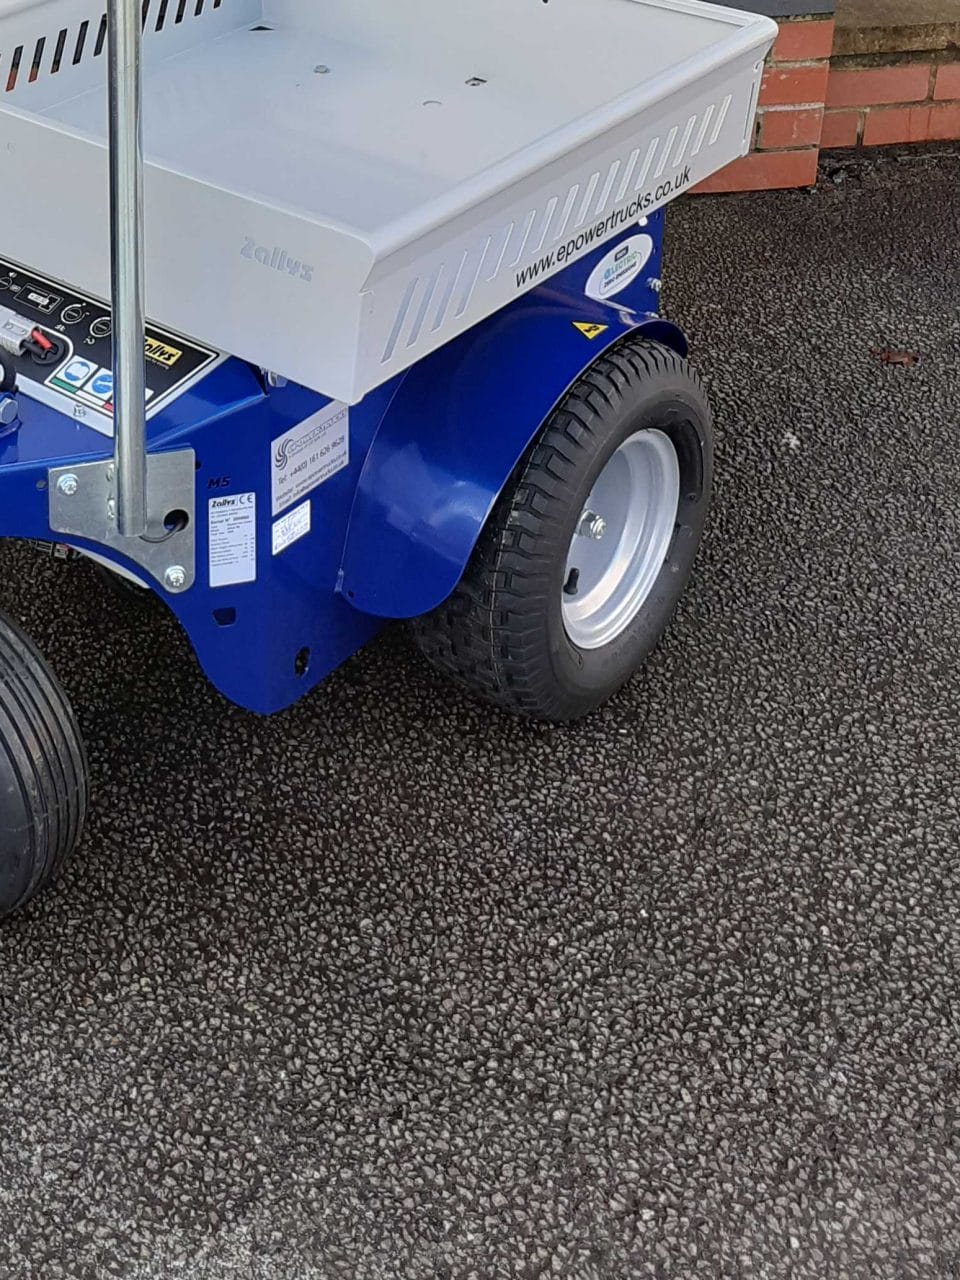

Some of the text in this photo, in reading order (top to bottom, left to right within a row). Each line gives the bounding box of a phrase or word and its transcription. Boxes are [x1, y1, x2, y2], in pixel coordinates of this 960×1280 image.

[515, 165, 691, 288] www.epowertrucks.co.uk
[241, 236, 314, 282] Zallys
[144, 340, 176, 361] allys
[207, 476, 231, 489] M5
